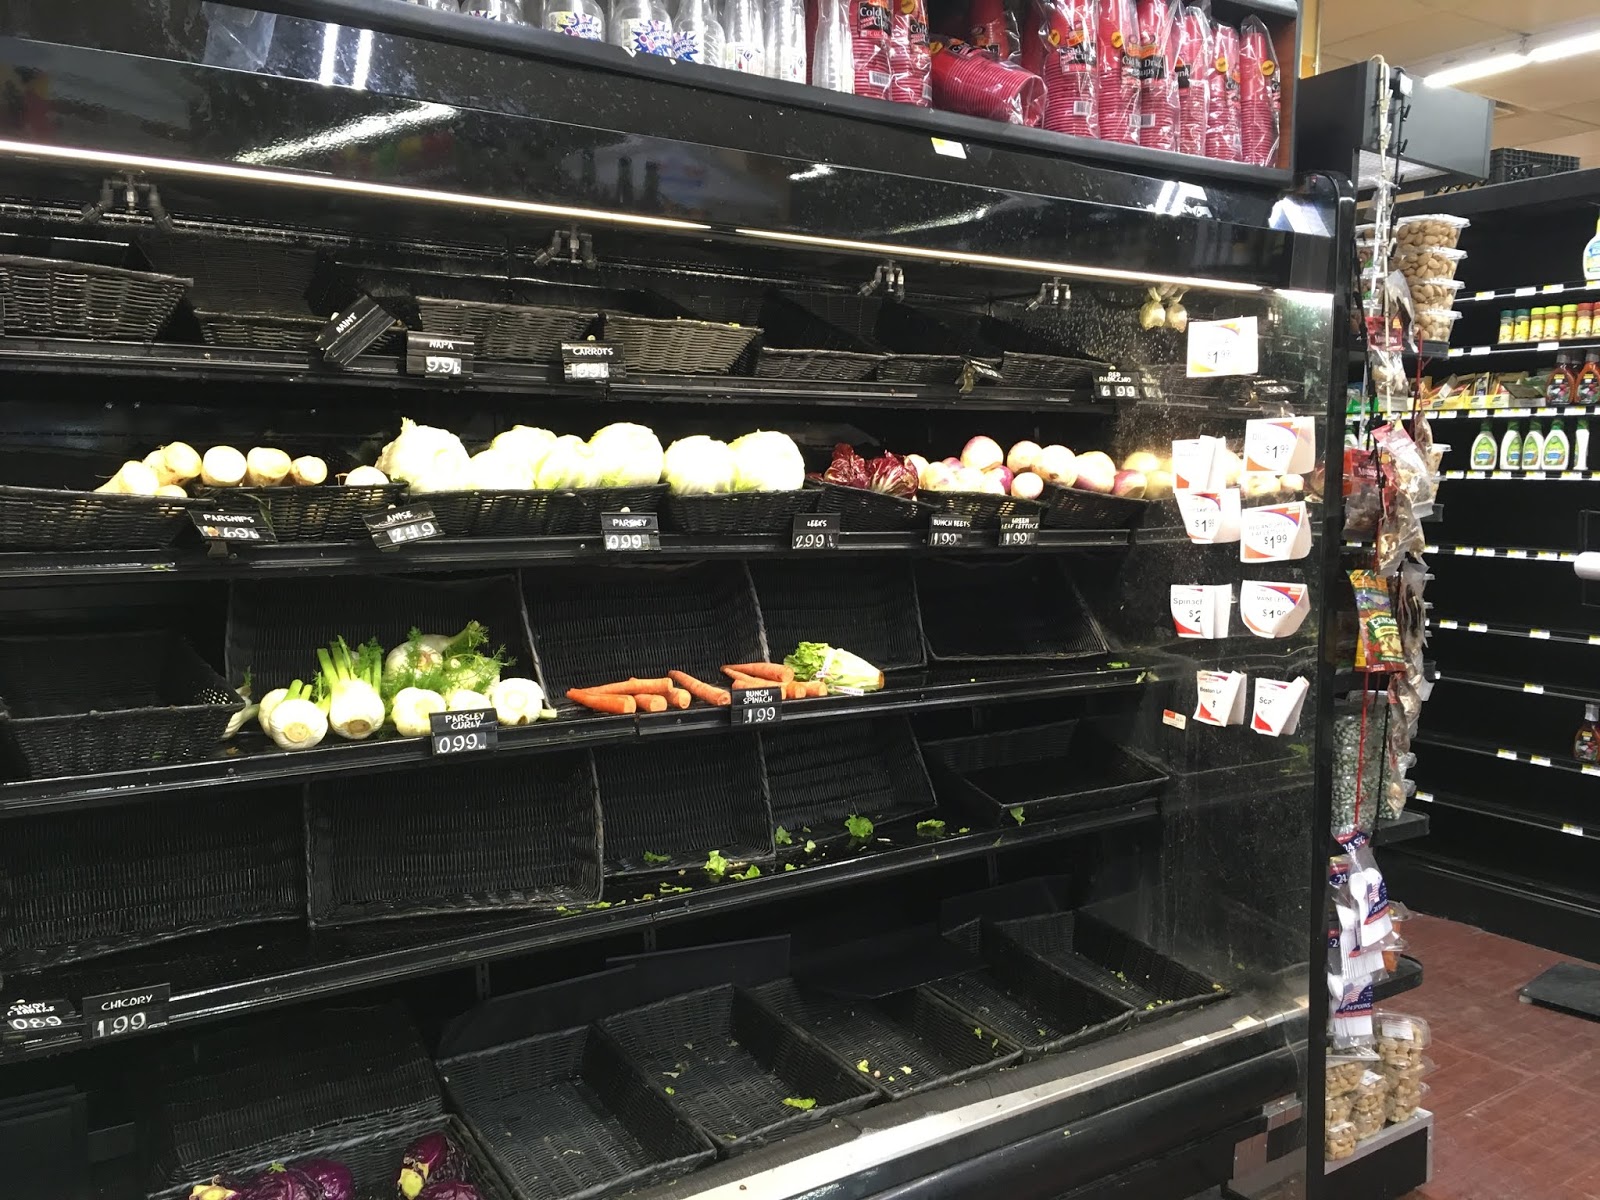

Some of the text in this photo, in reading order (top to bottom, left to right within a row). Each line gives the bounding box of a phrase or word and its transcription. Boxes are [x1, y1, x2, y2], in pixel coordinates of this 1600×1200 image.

[336, 312, 357, 333] MINT
[572, 347, 614, 356] CARROTS
[203, 514, 254, 523] PARSNIPS
[745, 689, 769, 698] BUNCH
[743, 695, 773, 704] SPINACH
[445, 712, 485, 723] PARSLEY
[451, 720, 481, 729] CURLY
[101, 994, 153, 1011] CHICORY
